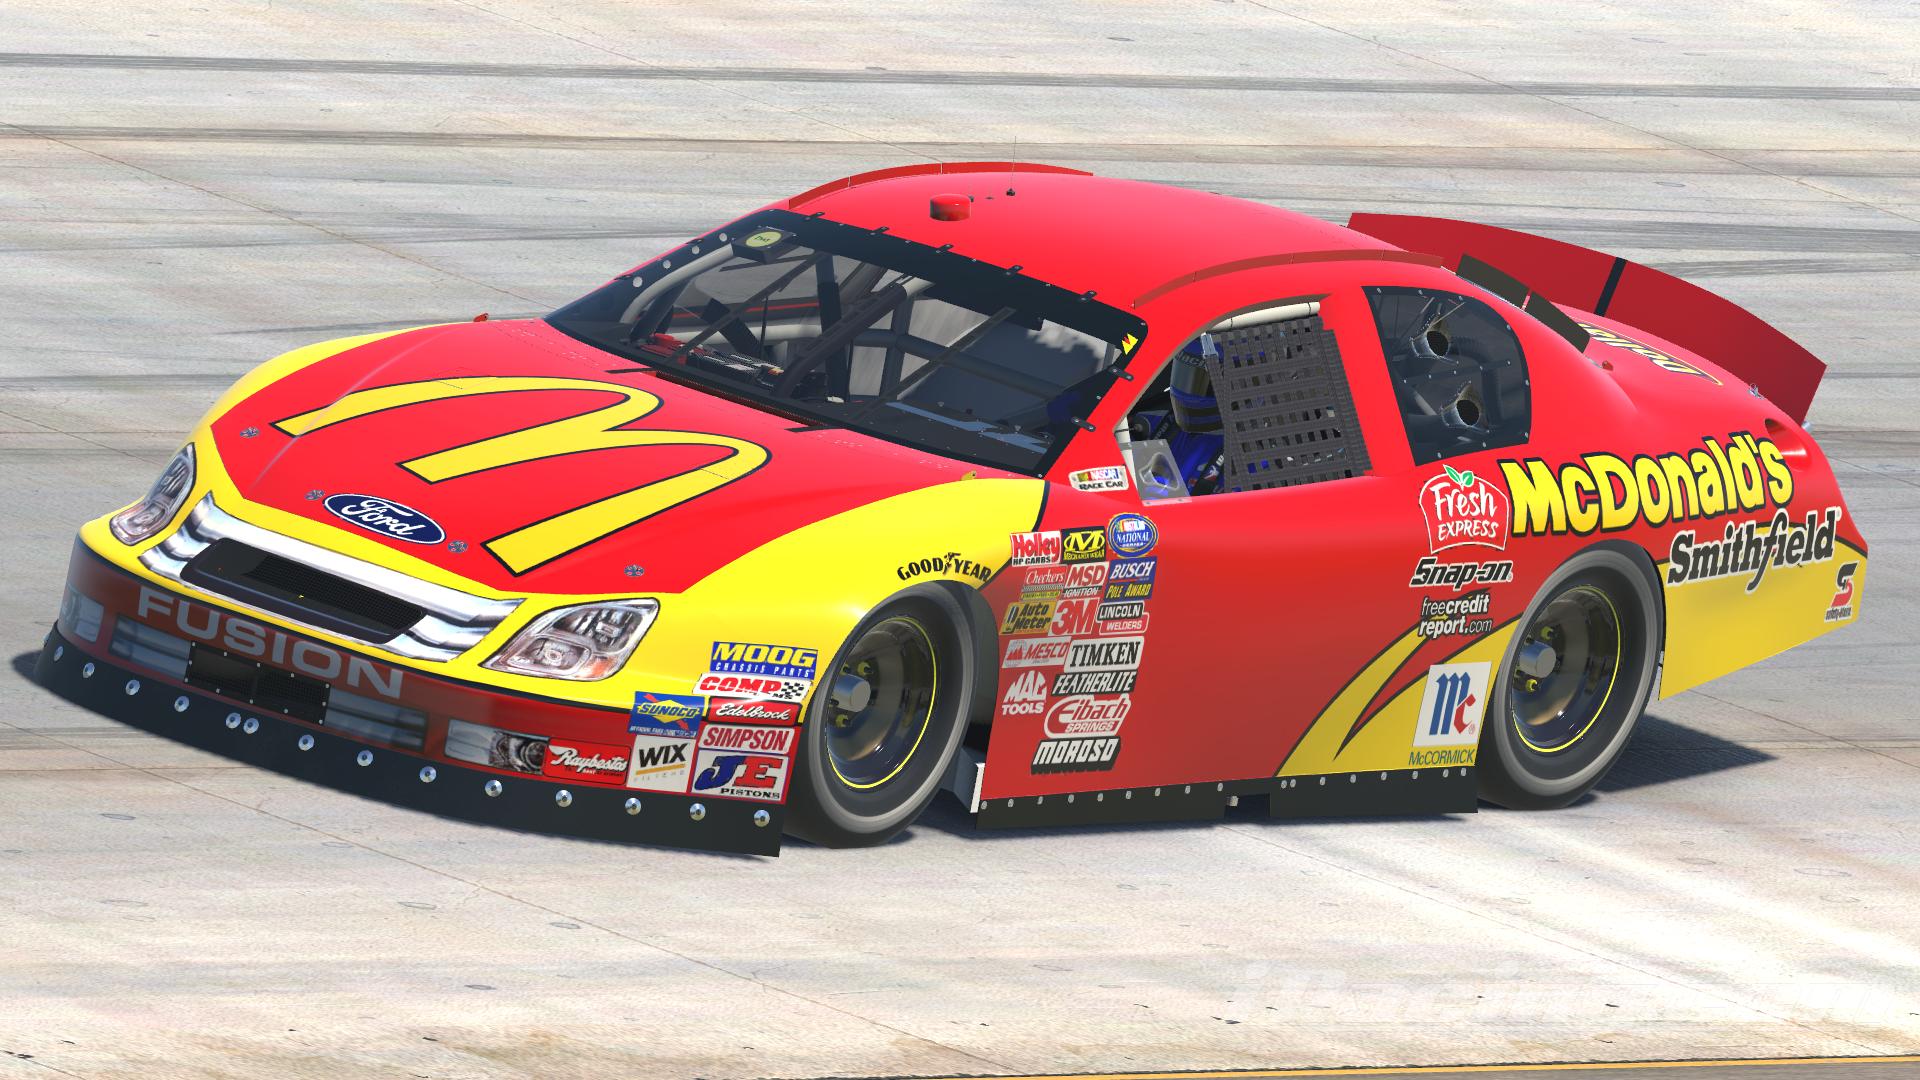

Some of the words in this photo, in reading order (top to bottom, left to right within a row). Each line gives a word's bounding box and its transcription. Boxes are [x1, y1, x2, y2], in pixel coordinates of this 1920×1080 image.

[1079, 482, 1104, 491] RACE
[1105, 480, 1124, 488] CAR
[1500, 433, 1793, 535] McDonald's
[1430, 481, 1498, 521] Fresh
[341, 499, 427, 536] Ford
[1116, 531, 1150, 544] NATIONAL
[1438, 519, 1499, 542] EXPRESS
[1011, 533, 1060, 562] Holley
[1668, 509, 1837, 594] Smithfield
[1013, 557, 1024, 566] HP
[1025, 555, 1051, 565] CARBS
[1110, 561, 1155, 580] BUSCH
[1025, 568, 1065, 585] Checkers
[1066, 565, 1107, 588] MSD
[1410, 556, 1512, 591] Snap-on
[1064, 586, 1098, 598] IGNITION
[1106, 585, 1123, 598] POLE
[1125, 583, 1152, 597] AWARD
[1020, 602, 1050, 617] Auto
[1052, 599, 1099, 635] 3M
[1100, 603, 1142, 619] LINCOLN
[1014, 615, 1051, 630] Meter
[1106, 620, 1143, 631] WELDERS
[138, 586, 403, 698] FUSION
[1024, 641, 1070, 660] MESCO
[712, 642, 818, 668] MOOG
[1069, 641, 1141, 668] TIMKEN
[715, 662, 766, 674] CHASSIS
[773, 667, 811, 679] PARTS
[699, 676, 782, 695] COMP
[1003, 670, 1047, 703] MAC
[1052, 671, 1137, 695] FEATHERLITE
[638, 703, 698, 718] SUNOCO
[716, 702, 790, 721] Edelbrock
[1001, 702, 1045, 716] TOOLS
[1047, 698, 1128, 728] Eibach
[1065, 720, 1115, 734] SPRINGS
[703, 727, 789, 751] SIMPSON
[548, 744, 628, 773] Raybestos
[638, 743, 688, 768] WIX
[1032, 738, 1120, 766] MOROSO
[1408, 749, 1476, 766] McCORMICK
[694, 754, 784, 791] JE
[720, 787, 780, 799] PISTONS
